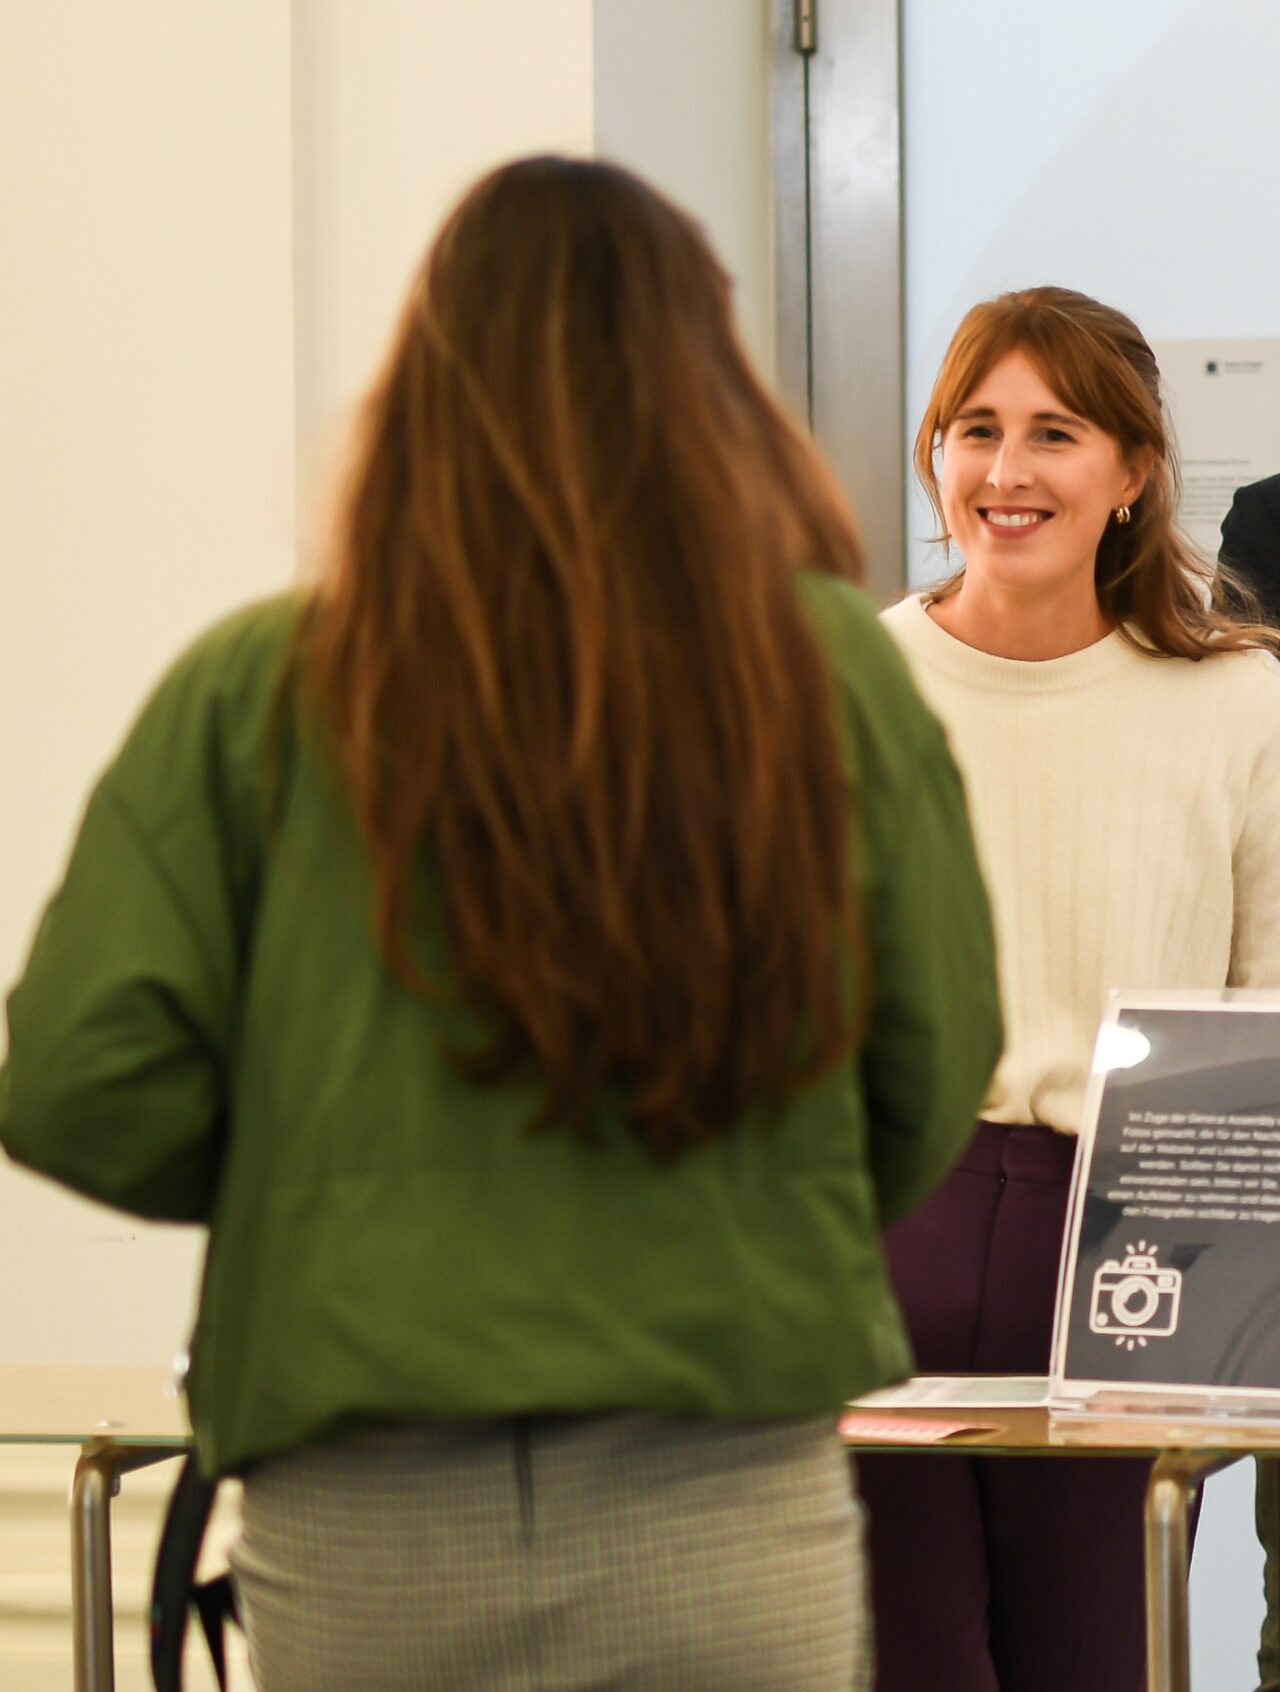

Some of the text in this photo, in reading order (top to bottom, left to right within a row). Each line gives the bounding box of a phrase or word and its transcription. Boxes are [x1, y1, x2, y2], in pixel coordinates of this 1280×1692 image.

[1144, 1112, 1169, 1125] Zuge
[1171, 1112, 1187, 1123] der
[1188, 1113, 1227, 1124] General
[1228, 1114, 1275, 1127] Assembly
[1123, 1126, 1151, 1138] Fotos
[1120, 1143, 1137, 1153] auf
[1138, 1143, 1154, 1153] der
